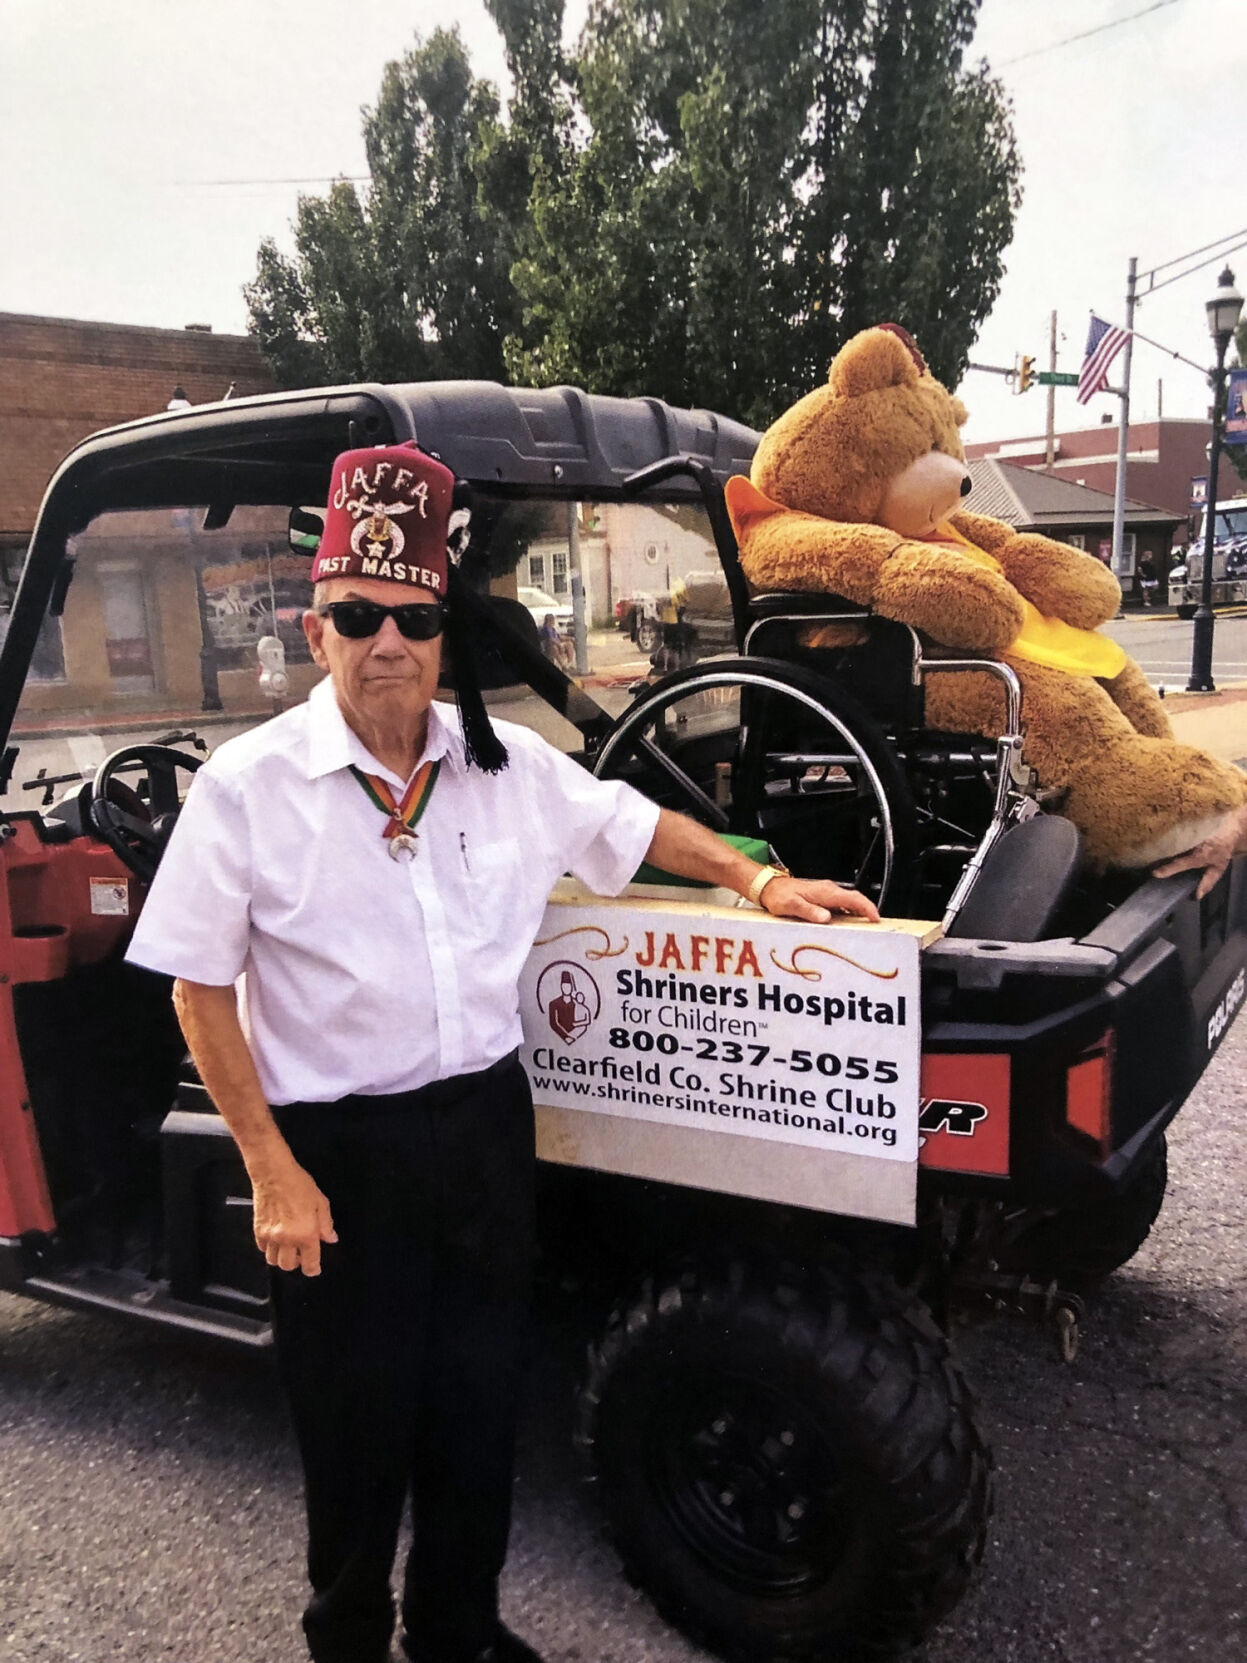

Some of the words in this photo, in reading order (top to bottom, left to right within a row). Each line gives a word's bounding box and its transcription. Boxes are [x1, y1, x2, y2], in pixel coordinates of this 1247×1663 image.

[333, 462, 429, 519] JAFFA
[318, 556, 350, 573] PAST
[361, 557, 441, 589] MASTER
[636, 931, 763, 978] JAFFA
[616, 969, 748, 1008] Shriners
[758, 983, 907, 1026] Hospital
[621, 1001, 652, 1025] for
[533, 1048, 660, 1086] Clearfield
[669, 1066, 710, 1093] Co.
[719, 1073, 817, 1108] Shrine
[826, 1088, 897, 1119] Club
[609, 1028, 899, 1085] 800-237-5055
[533, 1074, 898, 1146] www.shrinersinternational.org
